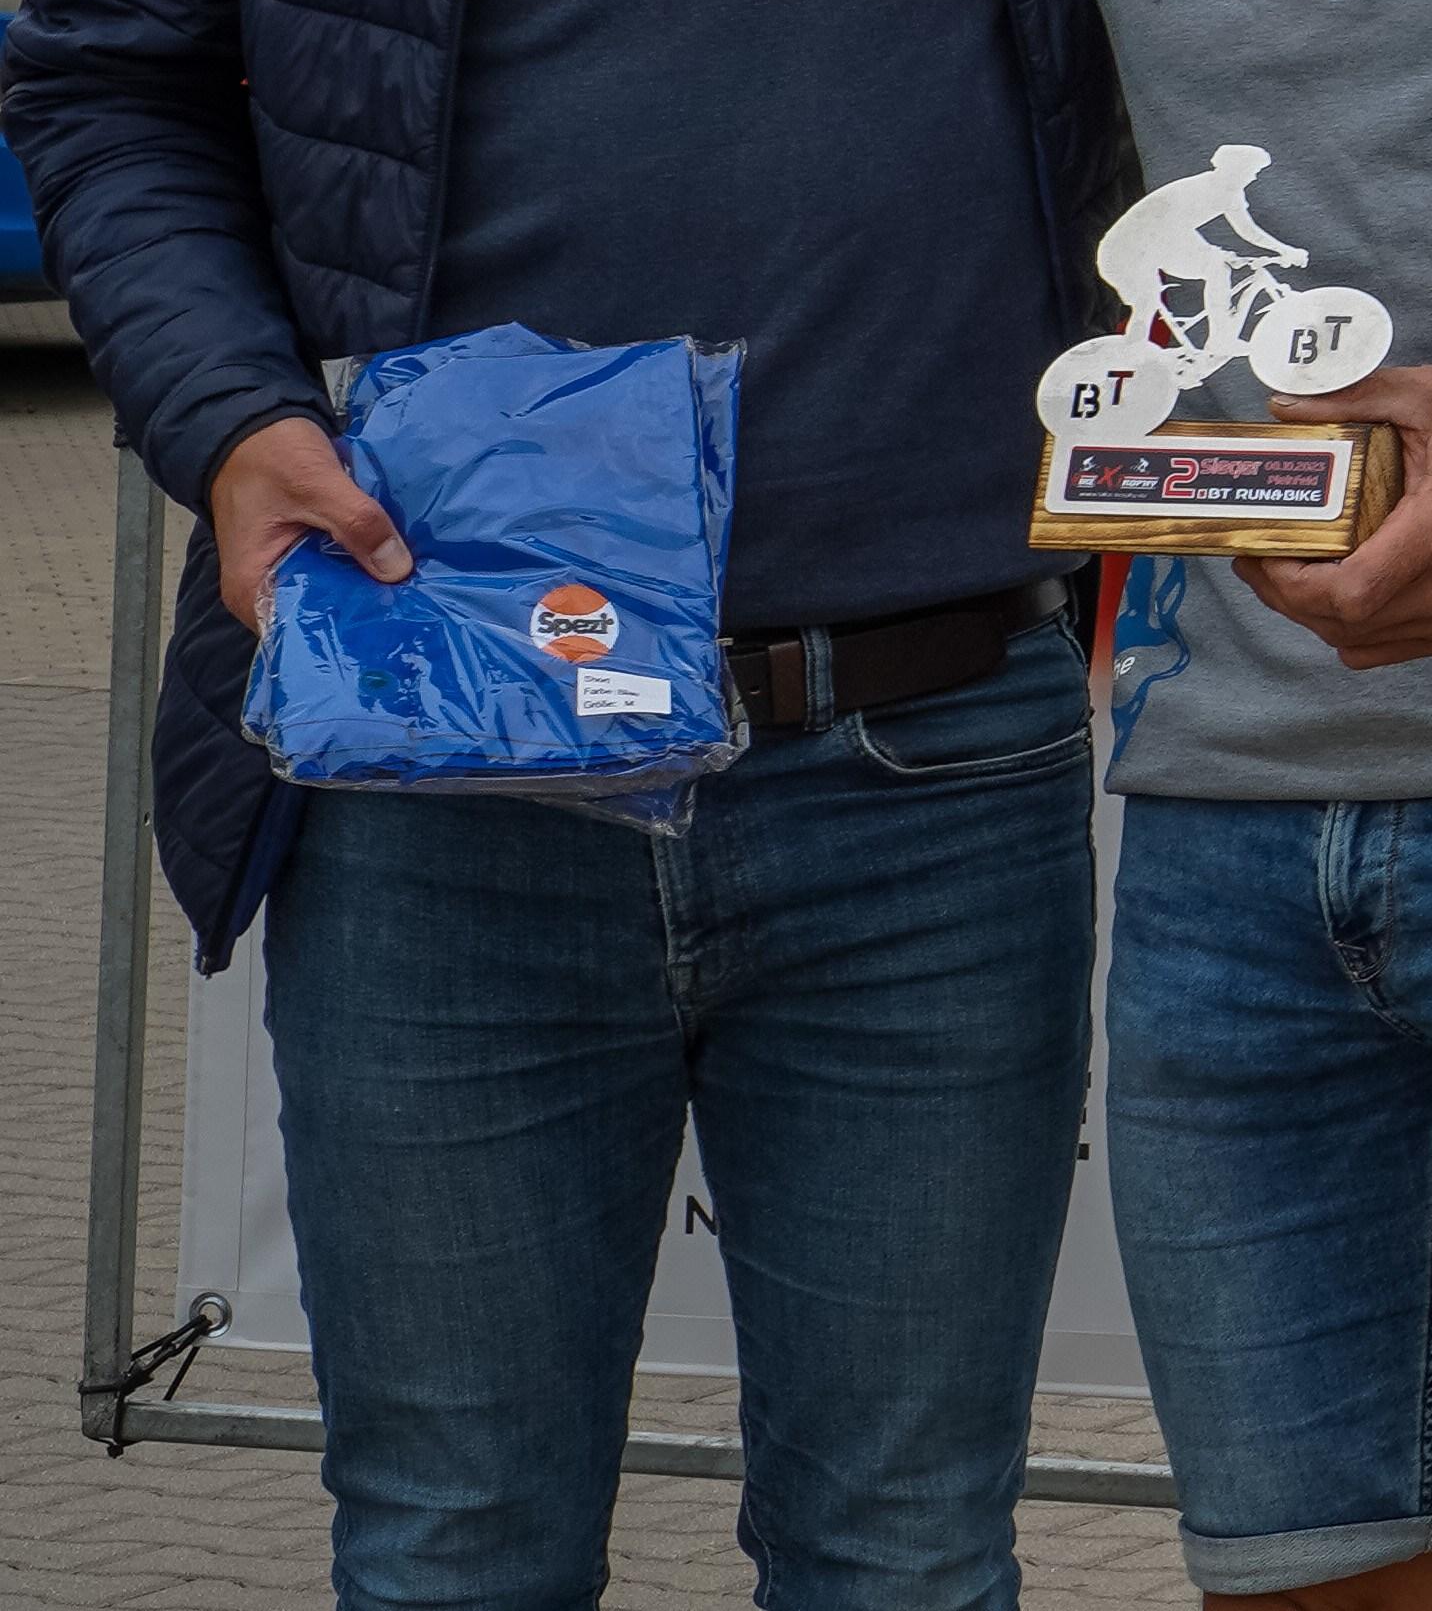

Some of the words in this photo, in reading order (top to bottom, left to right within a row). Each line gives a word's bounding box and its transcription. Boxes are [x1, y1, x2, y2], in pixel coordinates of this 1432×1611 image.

[1288, 316, 1352, 365] BT
[1070, 370, 1135, 418] BT
[1200, 457, 1264, 479] Sieger
[1208, 487, 1233, 500] BT
[1235, 488, 1323, 501] RUN&BIKE
[537, 611, 614, 637] Spezi
